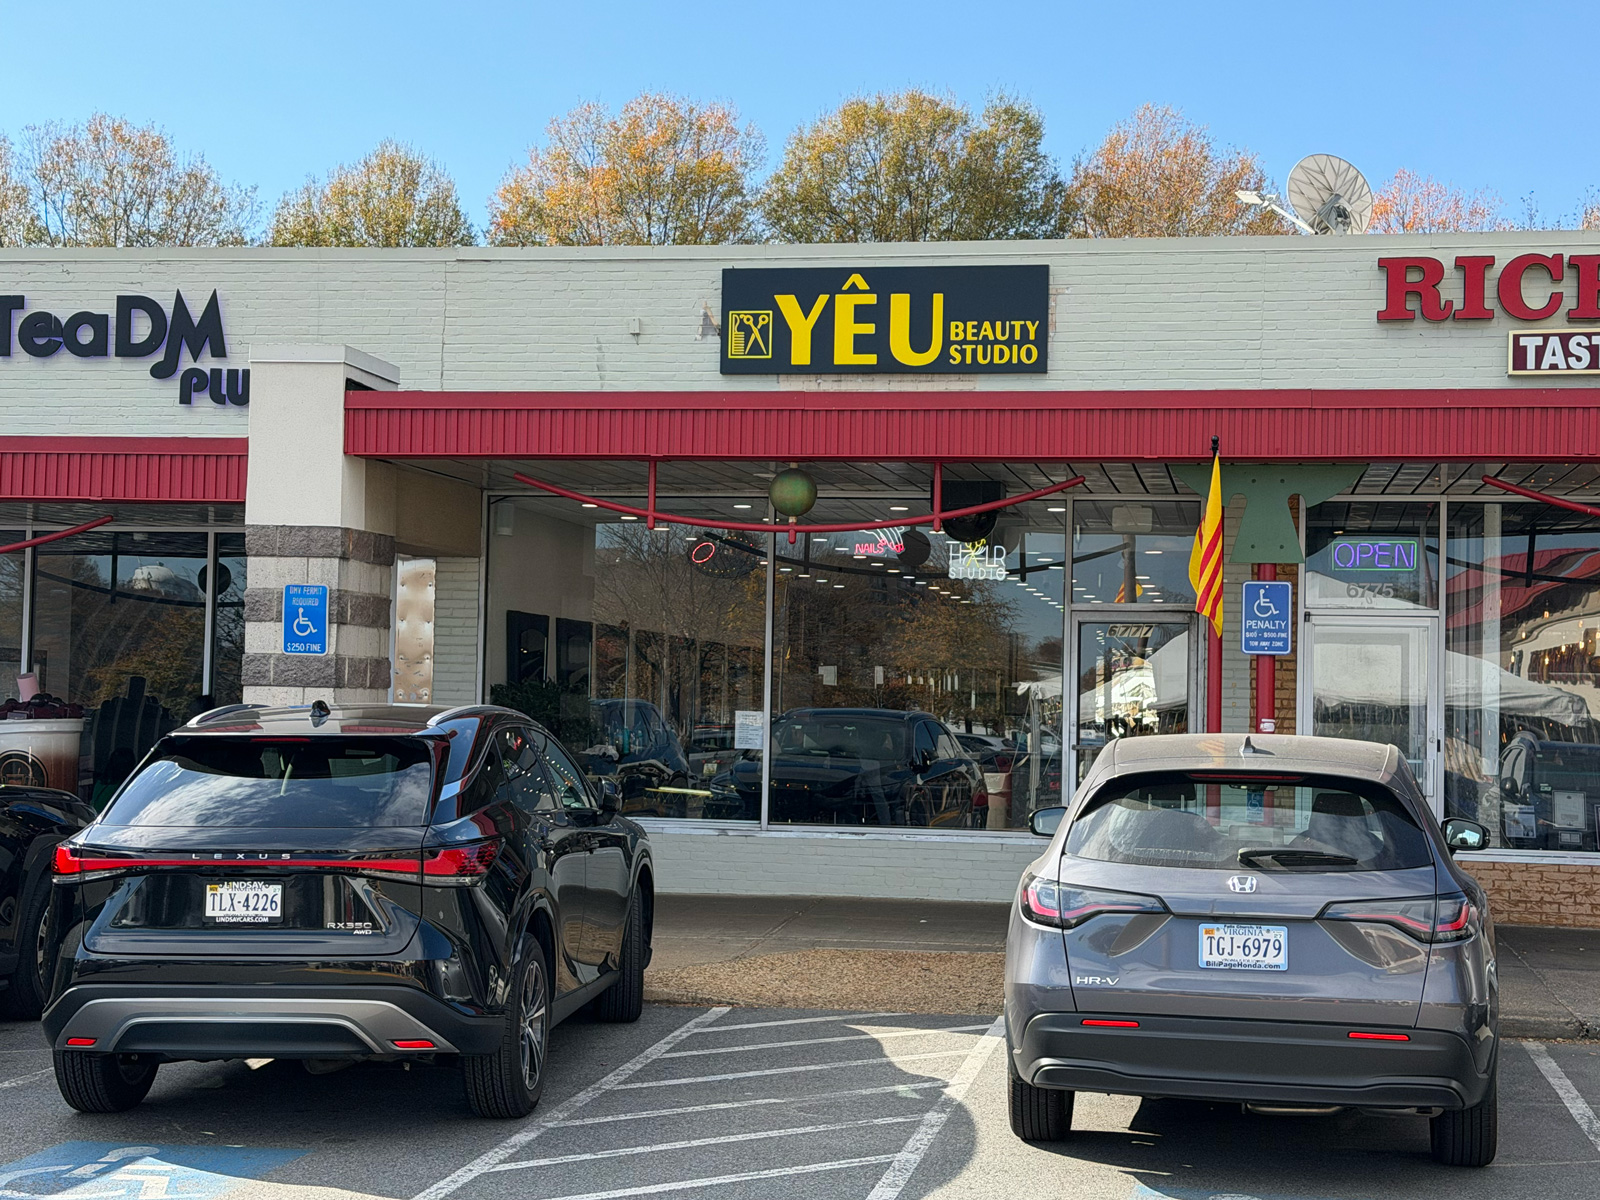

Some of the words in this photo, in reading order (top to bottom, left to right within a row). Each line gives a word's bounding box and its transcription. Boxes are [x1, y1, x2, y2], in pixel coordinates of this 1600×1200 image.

[774, 273, 944, 367] YÊU
[950, 320, 1040, 341] BEAUTY
[949, 344, 1039, 365] STUDIO
[854, 543, 884, 554] NAILS
[1334, 543, 1414, 568] OPEN
[949, 567, 1006, 580] STUDIO
[1346, 582, 1394, 598] 6775
[1108, 625, 1153, 637] 6777
[1246, 620, 1287, 629] PENALTY
[286, 642, 305, 652] $250
[305, 643, 322, 652] FINE
[209, 892, 279, 912] TLX-4226
[1222, 928, 1264, 937] VIRGINIA
[1206, 935, 1282, 958] TGJ-6979
[1076, 976, 1120, 985] HR-V
